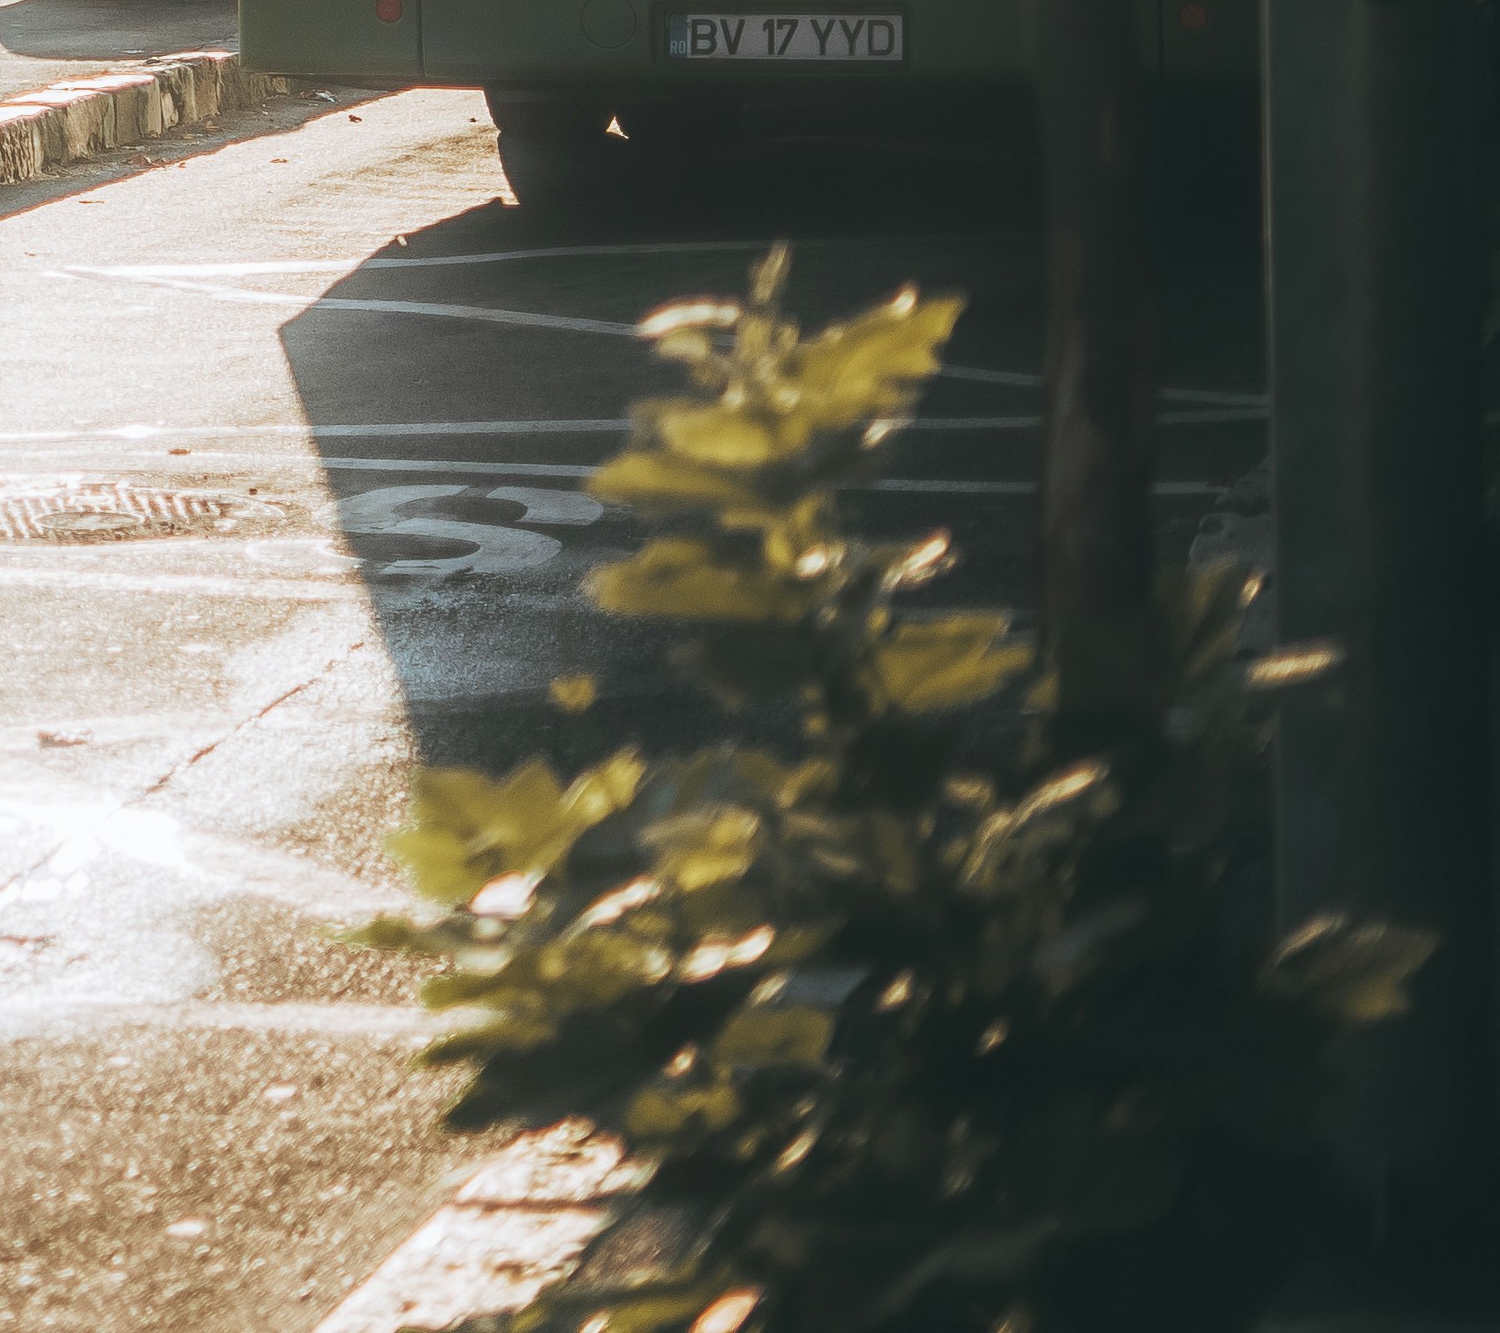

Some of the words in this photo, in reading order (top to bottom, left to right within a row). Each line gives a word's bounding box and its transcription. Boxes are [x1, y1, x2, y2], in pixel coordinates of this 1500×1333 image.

[669, 40, 686, 54] RO
[690, 19, 746, 56] BV
[762, 19, 800, 56] 17
[810, 19, 895, 56] YYD
